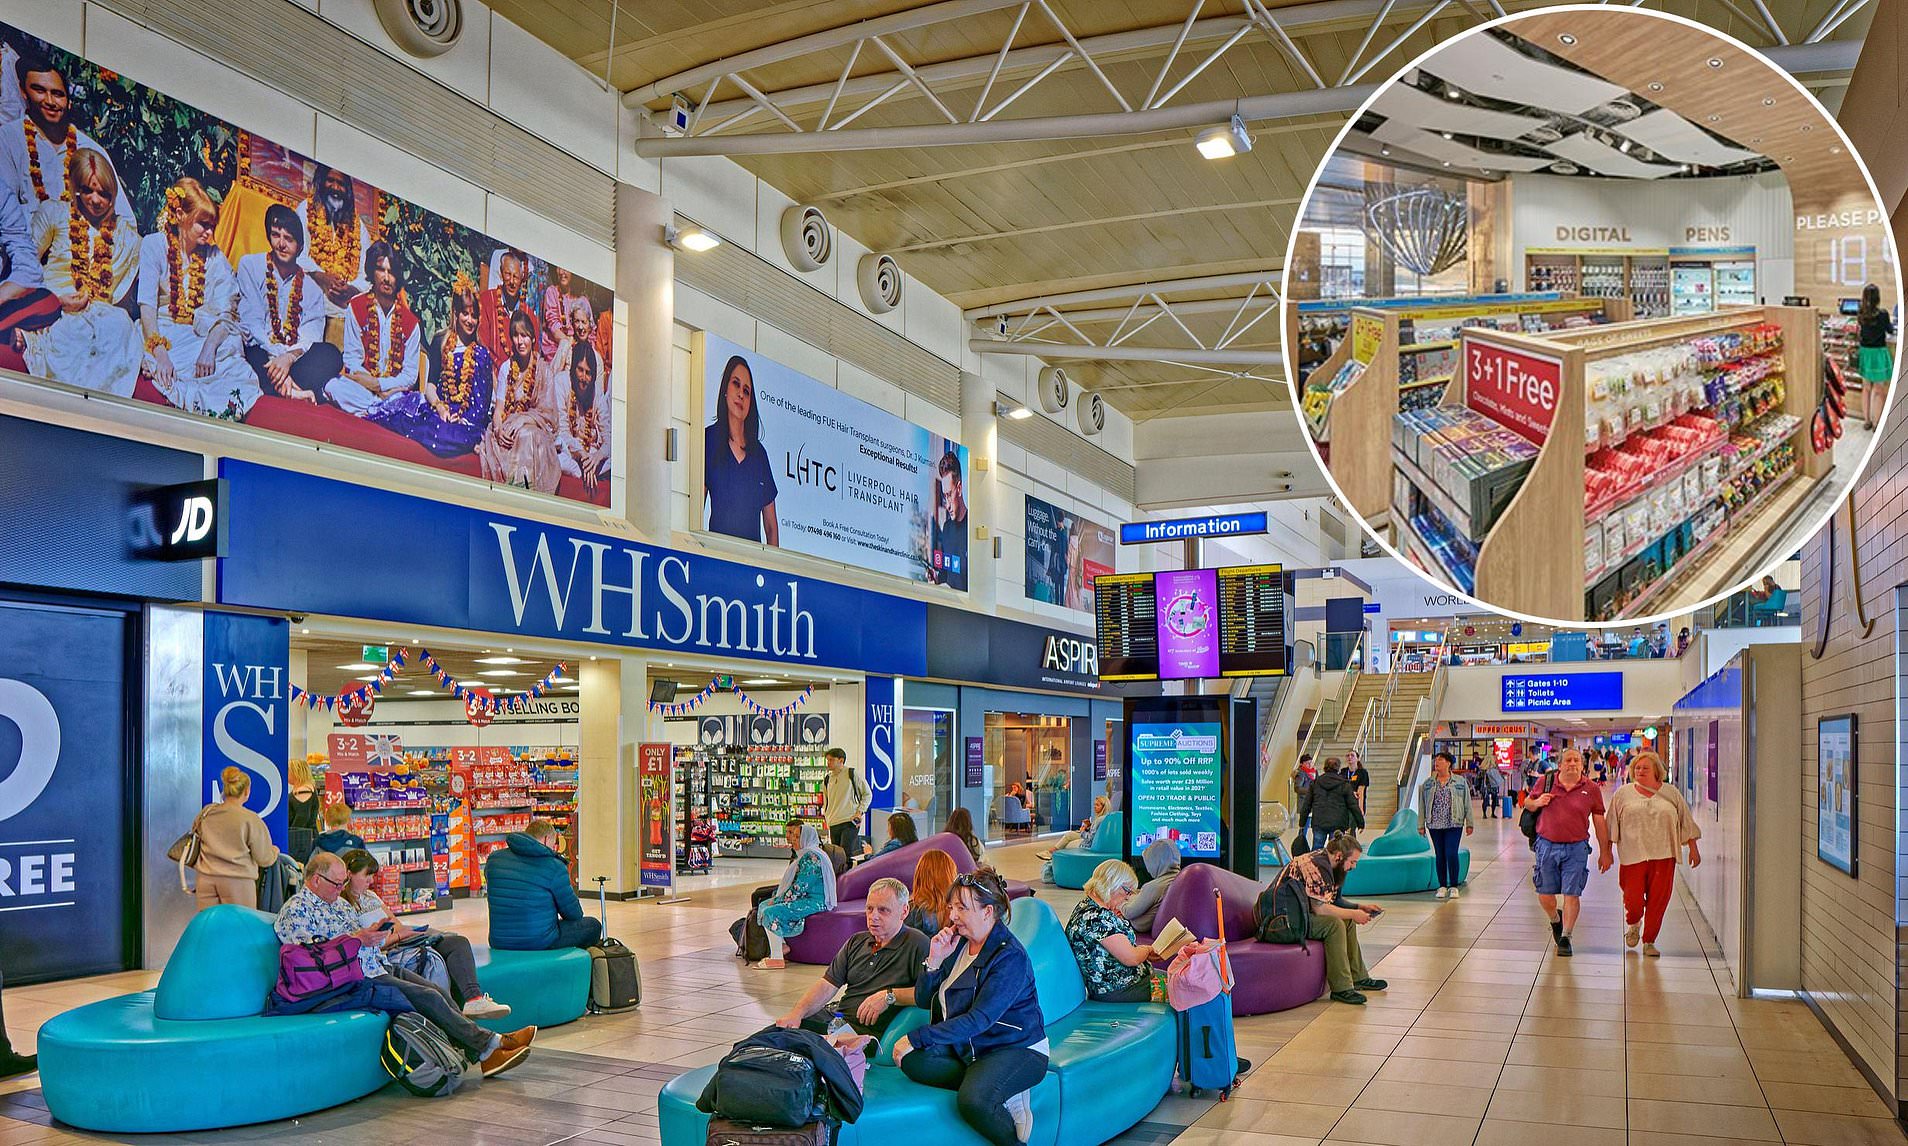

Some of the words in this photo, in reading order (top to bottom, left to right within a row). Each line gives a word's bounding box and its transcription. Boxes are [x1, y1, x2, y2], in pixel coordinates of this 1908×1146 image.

[1796, 210, 1863, 230] PLEASE
[1867, 209, 1883, 225] P
[1556, 226, 1631, 242] DIGITAL
[1685, 227, 1730, 242] PENS
[1472, 349, 1501, 390] 3+1
[1506, 360, 1554, 410] Free
[760, 390, 776, 404] One
[776, 398, 784, 408] of
[785, 401, 796, 413] the
[798, 404, 822, 425] leading
[822, 415, 836, 429] FUE
[836, 421, 849, 434] Hair
[850, 427, 880, 447] Transplant
[880, 440, 906, 458] surgeons,
[786, 442, 837, 492] LHTC
[859, 444, 895, 466] Exceptional
[895, 457, 918, 474] Results!
[847, 471, 896, 497] LIVERPOOL
[899, 489, 919, 505] HAIR
[848, 486, 904, 513] TRANSPLANT
[171, 496, 213, 545] JD
[781, 518, 791, 528] Call
[822, 519, 834, 529] Book
[1145, 517, 1240, 539] Information
[1027, 520, 1049, 538] Without
[1048, 527, 1057, 541] the
[488, 521, 817, 658] WHSmith
[1424, 595, 1470, 606] WORL
[213, 663, 283, 699] WH
[1528, 689, 1554, 697] Toilets
[1527, 698, 1551, 706] Picnic
[1552, 698, 1571, 706] Area
[871, 703, 893, 724] WH
[1502, 725, 1526, 734] CRUST
[336, 737, 345, 751] 3
[349, 738, 358, 751] 2
[1140, 740, 1175, 748] SUPREME
[212, 700, 283, 819] S
[645, 748, 665, 757] ONLY
[870, 724, 894, 792] S
[647, 757, 663, 772] £1
[1141, 758, 1152, 767] Up
[1164, 757, 1182, 765] 90%
[1183, 757, 1197, 765] Off
[1197, 757, 1214, 765] RRP
[908, 774, 936, 786] ASPIRE
[1193, 769, 1214, 777] weekly
[643, 871, 669, 880] WHSmith
